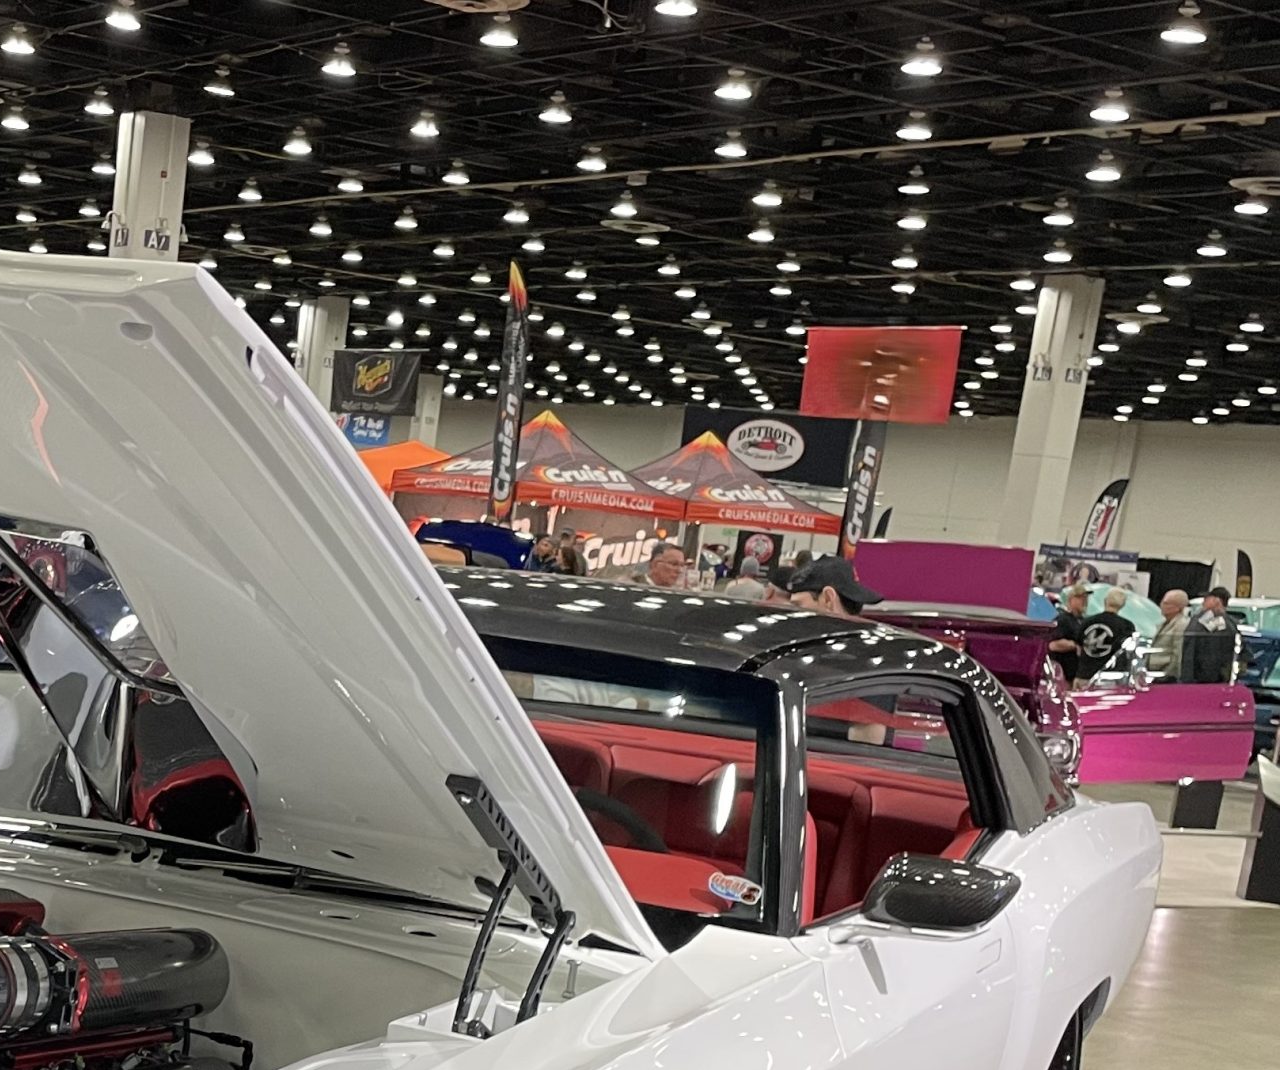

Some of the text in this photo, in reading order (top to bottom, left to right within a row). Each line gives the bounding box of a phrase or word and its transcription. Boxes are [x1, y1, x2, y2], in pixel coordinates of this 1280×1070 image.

[493, 392, 519, 501] Cruis'n
[738, 426, 797, 447] DETROIT
[544, 465, 628, 483] Cruis'n
[551, 488, 655, 511] CRUISNMEDIA.COM
[710, 484, 785, 502] Cruis'n
[847, 445, 876, 545] Cruis'n
[718, 508, 816, 528] CRUISNMEDIA.COM
